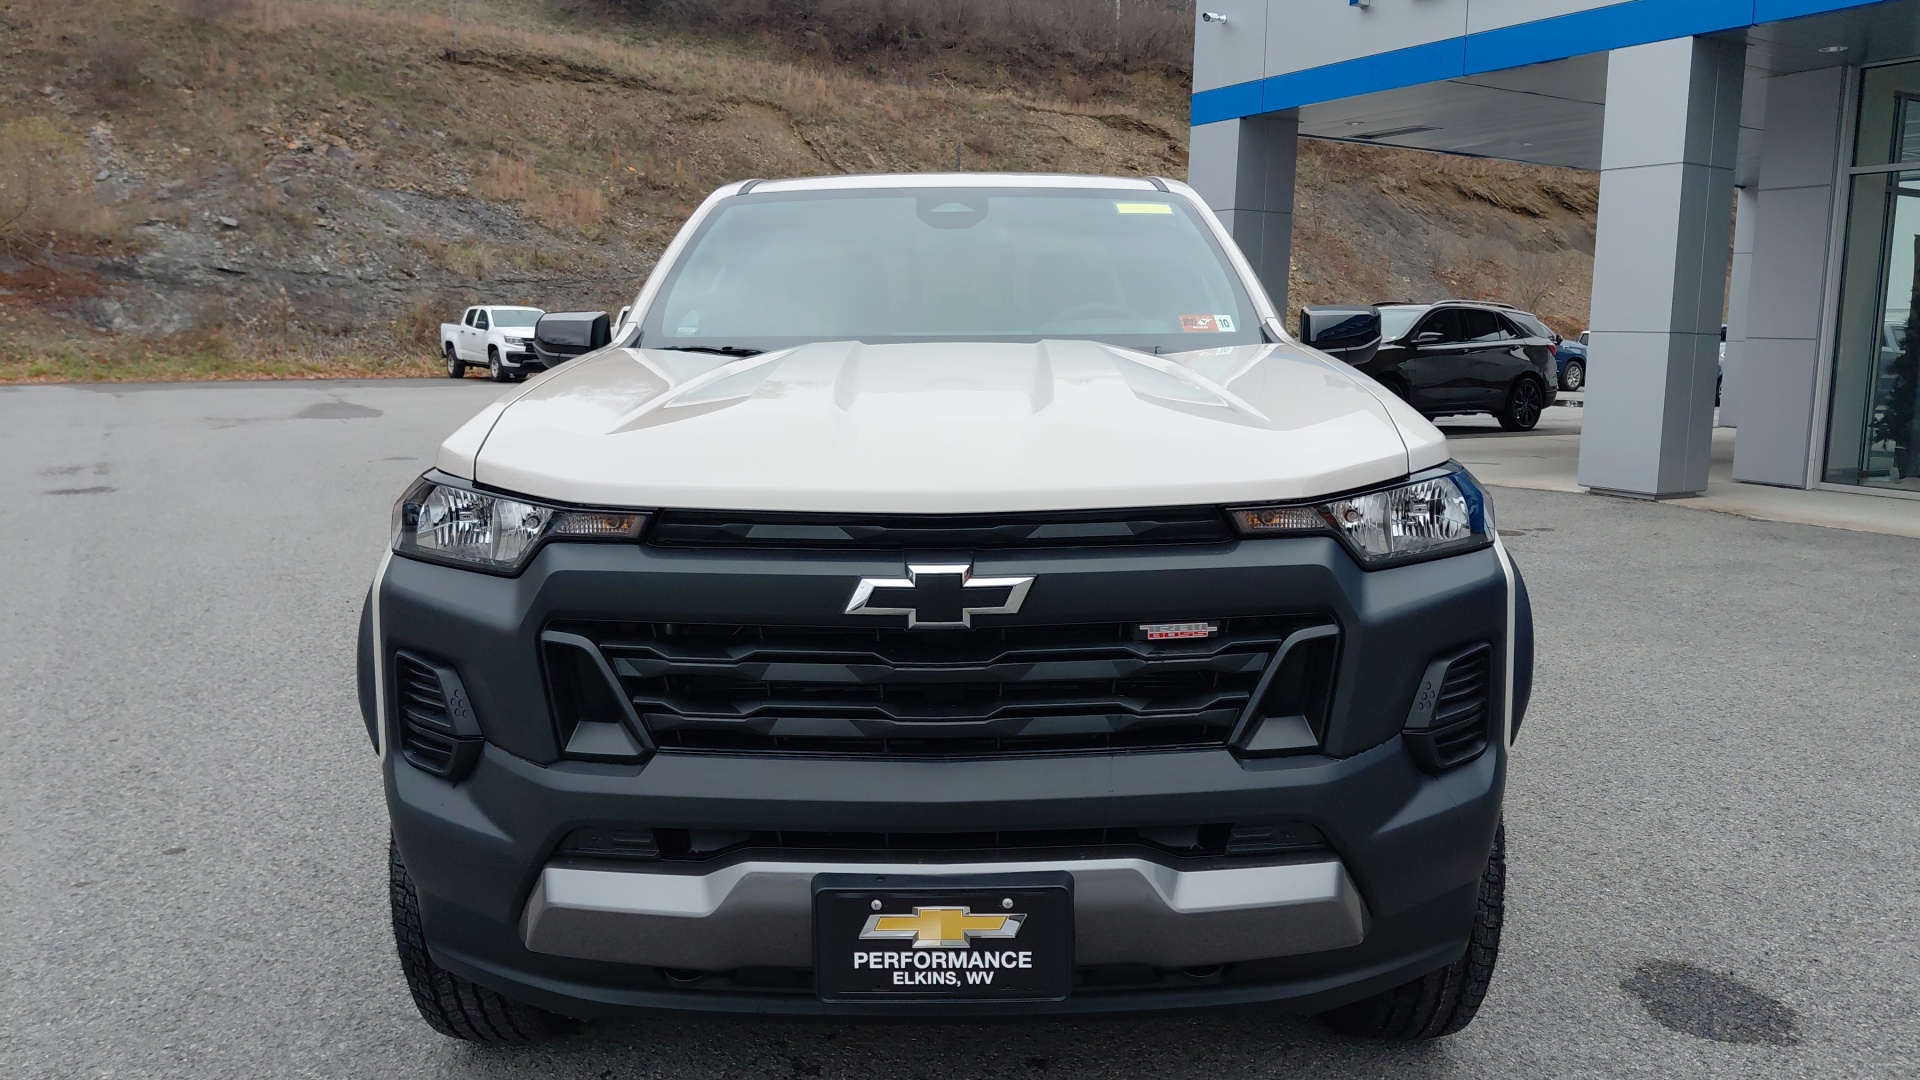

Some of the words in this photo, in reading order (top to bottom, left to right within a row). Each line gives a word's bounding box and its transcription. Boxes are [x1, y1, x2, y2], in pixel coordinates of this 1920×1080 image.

[1219, 318, 1230, 328] 10
[1147, 631, 1208, 640] BOSS
[853, 951, 1033, 969] PERFORMANCE
[893, 971, 961, 987] ELKINS,
[966, 971, 994, 985] WV
